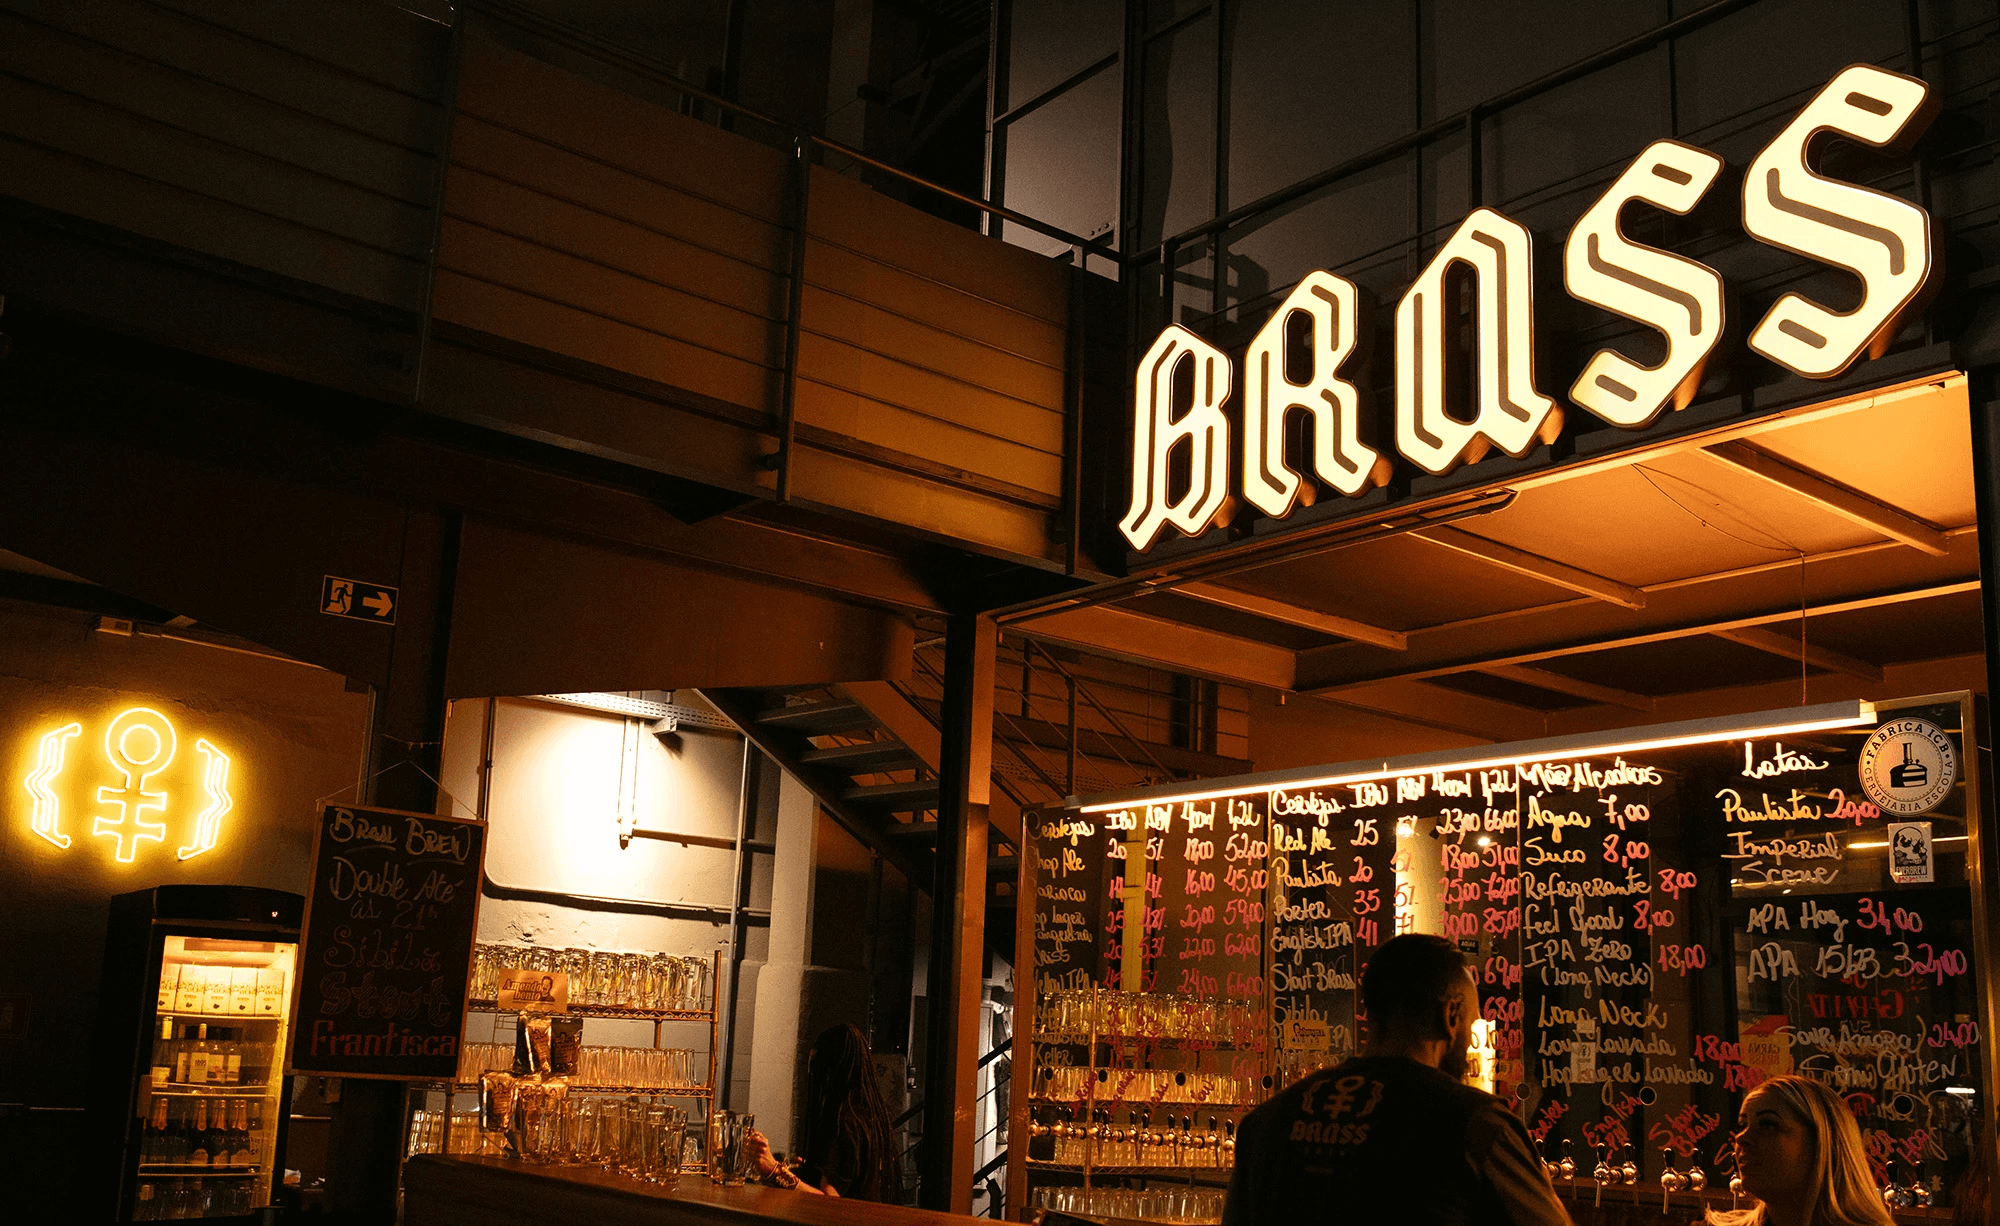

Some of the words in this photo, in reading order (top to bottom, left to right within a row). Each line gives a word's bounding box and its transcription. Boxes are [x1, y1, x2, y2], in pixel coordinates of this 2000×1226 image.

[1116, 62, 1933, 554] BRASS
[1866, 722, 1923, 759] FABRICA
[1927, 728, 1950, 755] ICB
[1741, 741, 1829, 779] Latas
[1864, 767, 1922, 812] CERVEJARIA
[1925, 760, 1953, 806] ESCOLA
[1597, 794, 1650, 831] 7,00
[1715, 788, 1821, 822] Paulista
[1107, 838, 1128, 859] 20
[1224, 833, 1268, 865] 52,00
[1350, 819, 1379, 846] 25
[1524, 836, 1587, 866] Suco
[1602, 833, 1650, 868] 8,00
[1224, 865, 1268, 897] 45,00
[1272, 857, 1342, 888] Paulista
[1349, 856, 1373, 883] 20
[1658, 868, 1697, 900] 8,00
[1353, 888, 1380, 915] 35
[1633, 900, 1675, 936] 8,00
[1746, 903, 1790, 933] APA
[1524, 939, 1576, 968] IPA
[1658, 944, 1706, 977] 18,00
[1748, 942, 1800, 983] APA
[319, 970, 450, 1028] Stout
[310, 1019, 457, 1058] Frantisca
